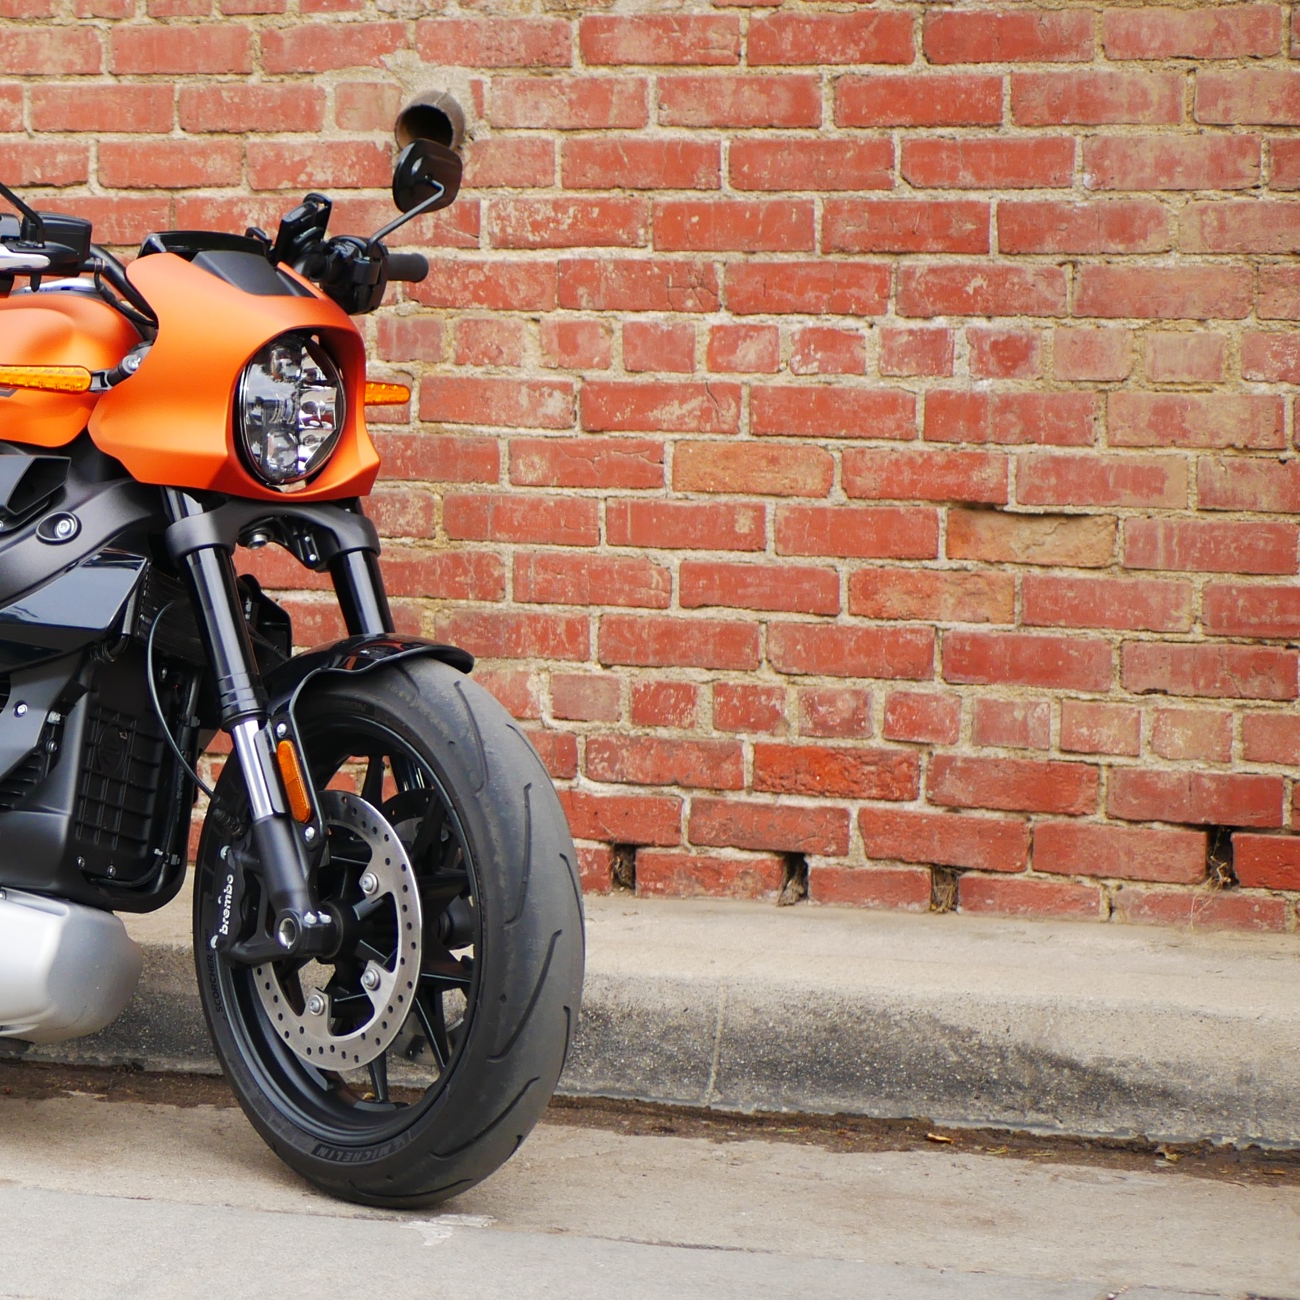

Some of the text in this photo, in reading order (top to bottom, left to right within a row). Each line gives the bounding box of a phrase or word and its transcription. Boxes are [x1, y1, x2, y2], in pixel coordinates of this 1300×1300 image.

[219, 874, 234, 935] brembo
[207, 954, 223, 1013] SCORCHER
[316, 1144, 390, 1162] MICHELIN
